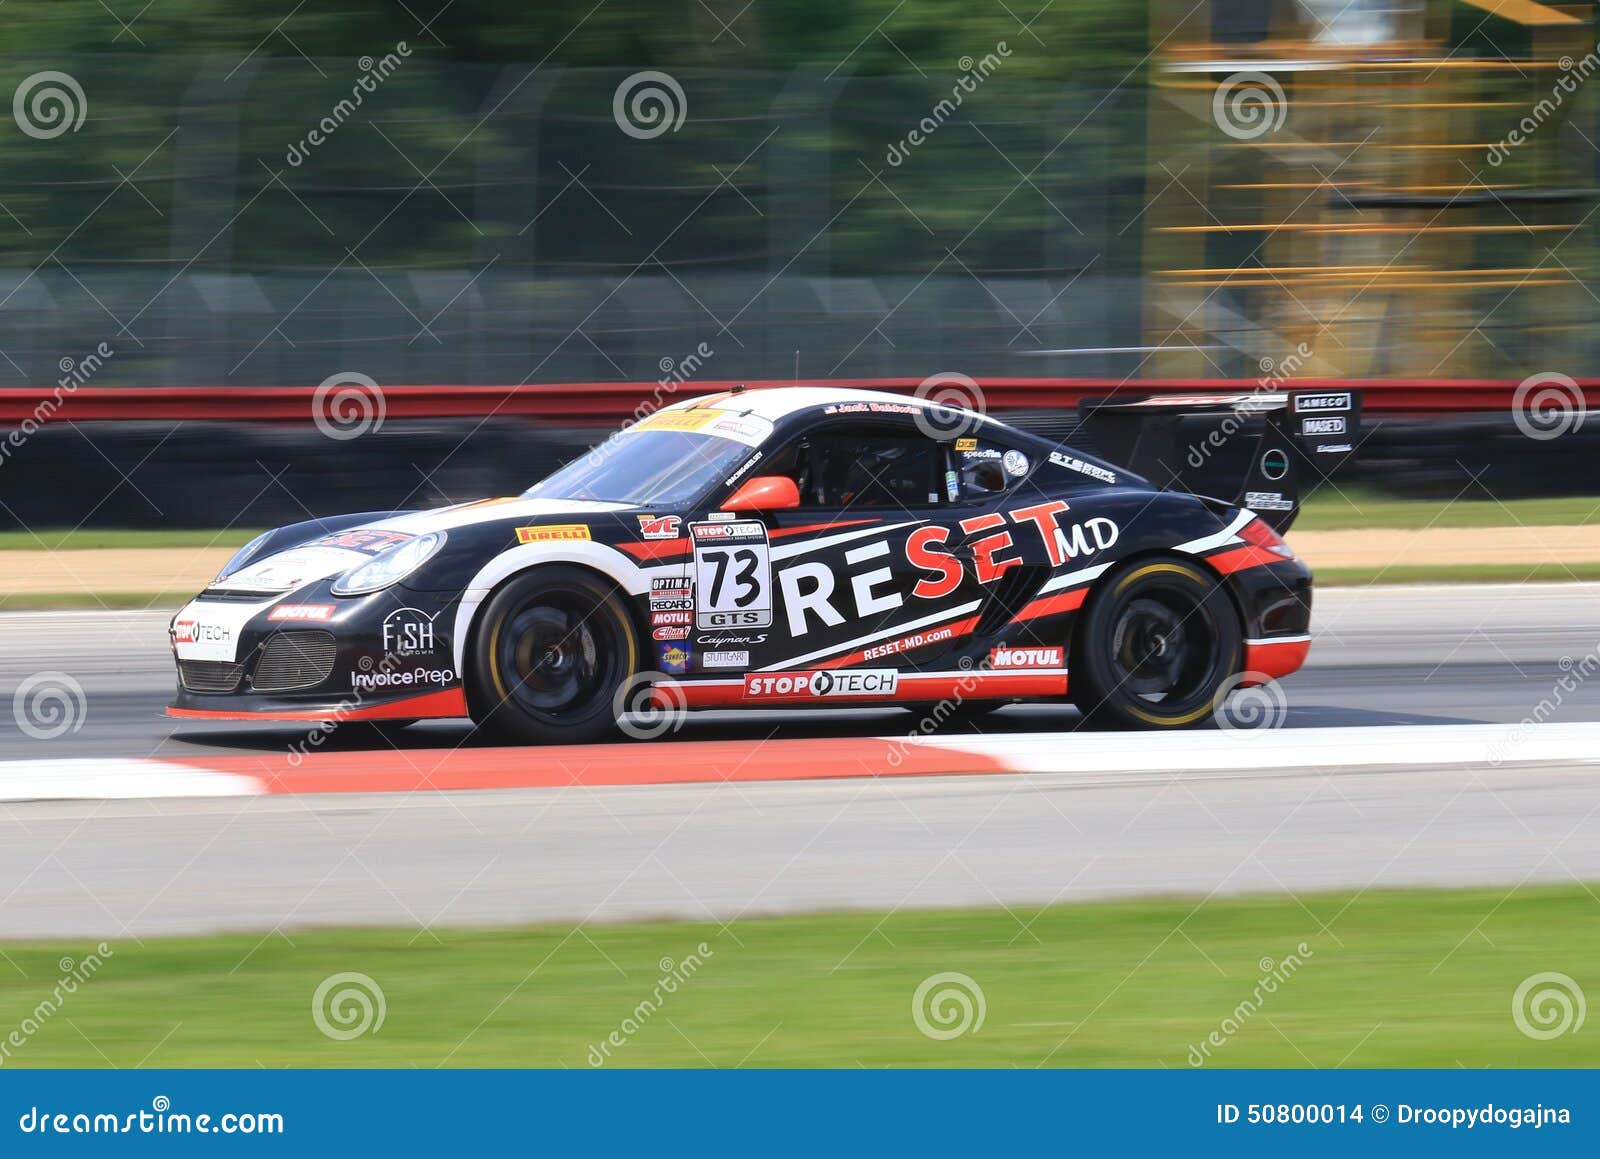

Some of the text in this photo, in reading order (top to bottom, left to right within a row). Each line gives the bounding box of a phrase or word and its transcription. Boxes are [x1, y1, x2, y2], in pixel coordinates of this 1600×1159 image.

[520, 527, 587, 541] PIRELLI
[698, 526, 761, 536] STOP TECH
[778, 500, 1119, 637] RESET MD
[653, 578, 690, 589] OPTIMA
[702, 549, 761, 608] 73
[651, 600, 692, 610] RECARO
[272, 606, 330, 619] MOTUL
[654, 613, 690, 624] MOTUL
[711, 612, 758, 626] GTS
[201, 625, 230, 640] TECH
[697, 634, 769, 648] Cayman S
[863, 628, 952, 661] RESET-MD.com
[994, 650, 1060, 666] MOTUL
[351, 668, 453, 687] InvoicePrep
[749, 674, 894, 695] STOP TECH
